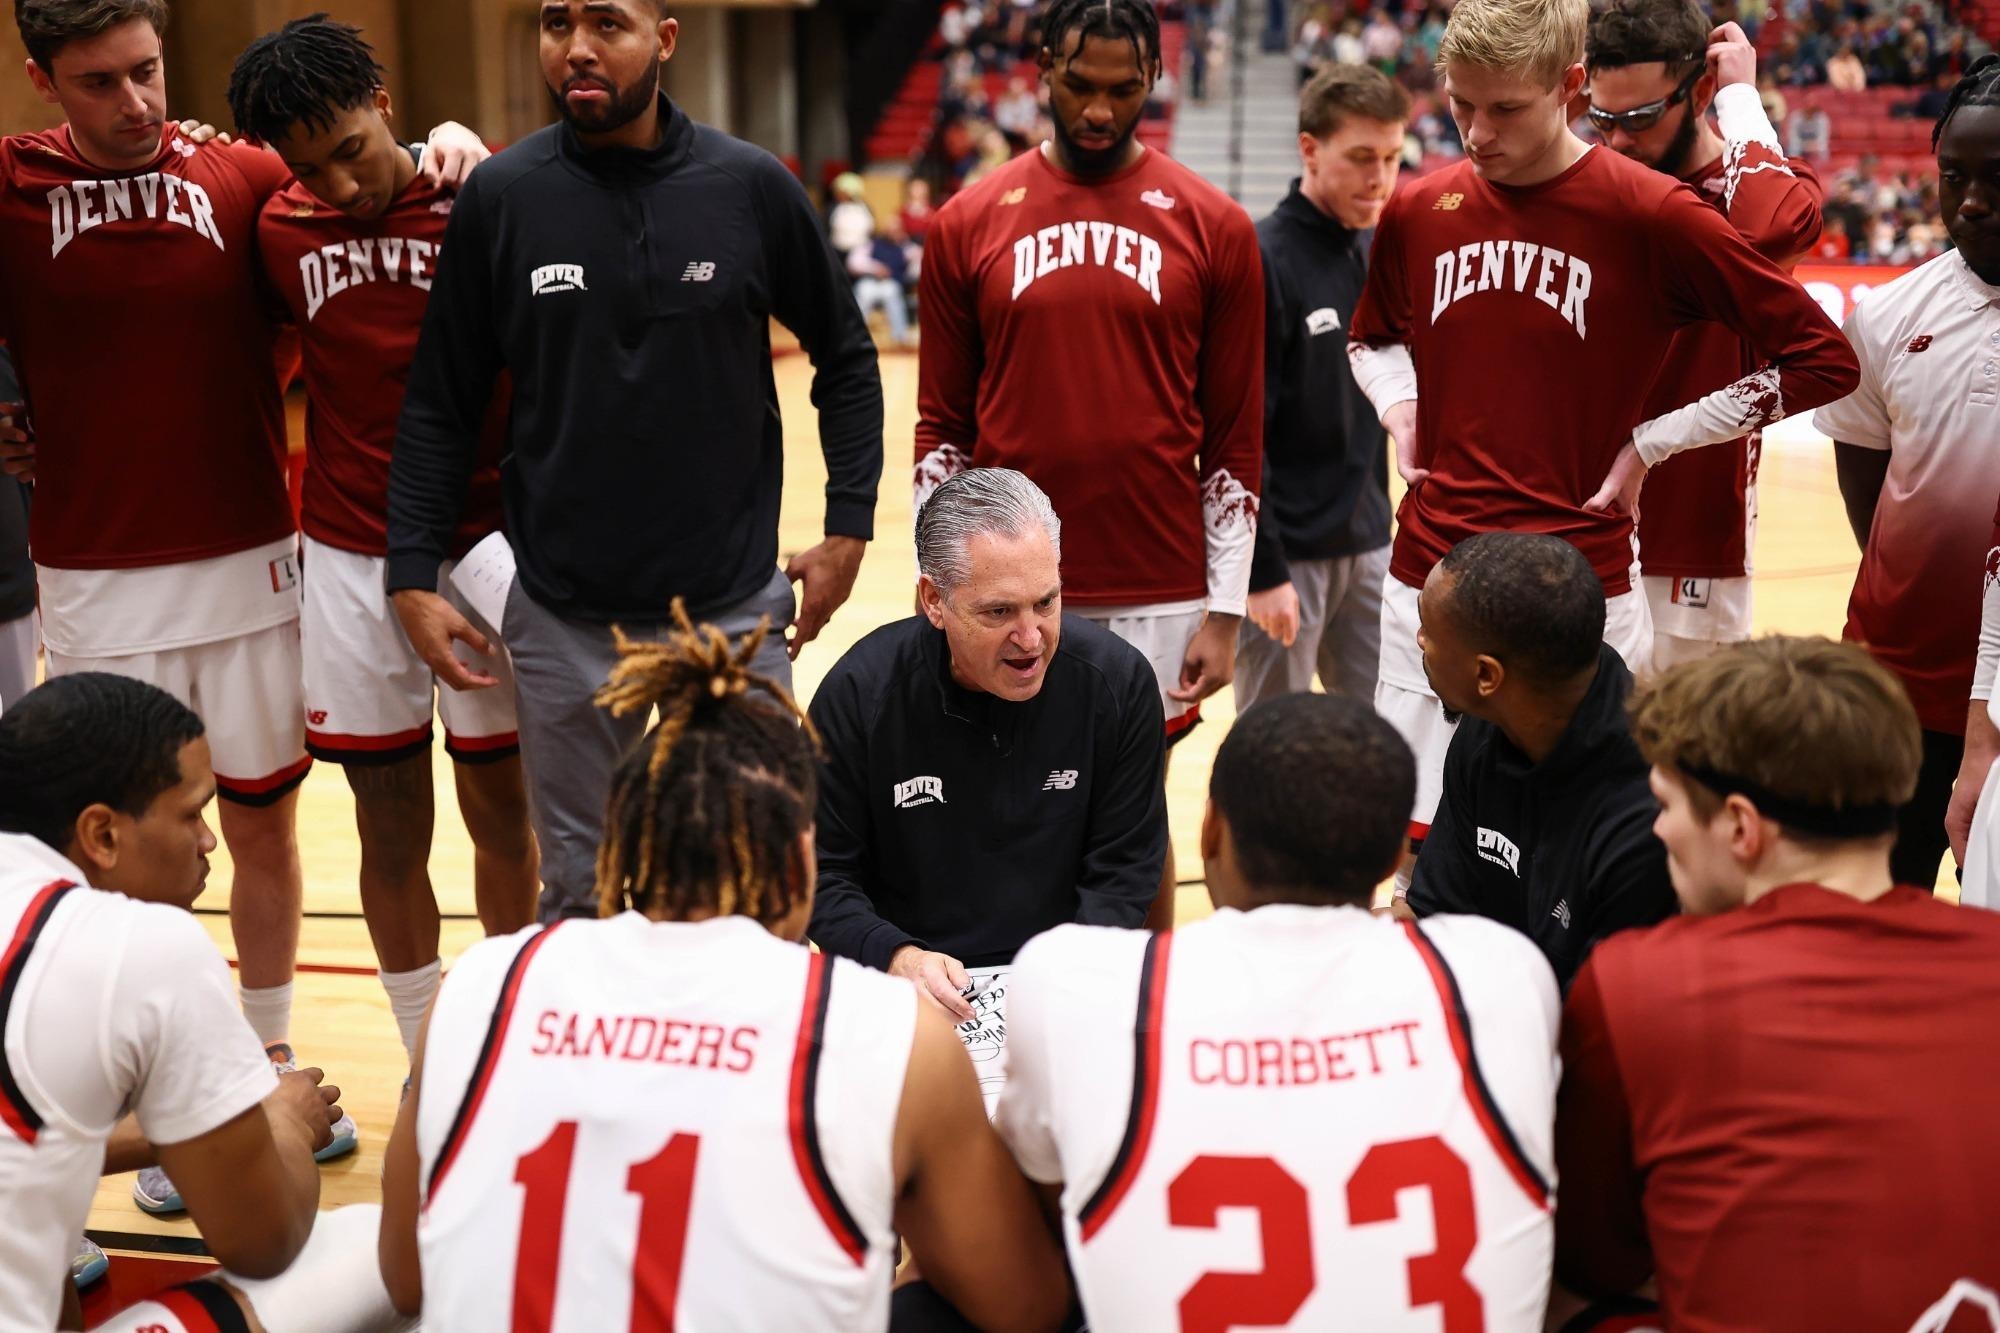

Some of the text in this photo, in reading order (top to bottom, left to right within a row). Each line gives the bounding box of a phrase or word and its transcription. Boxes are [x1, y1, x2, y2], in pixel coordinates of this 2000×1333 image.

[46, 172, 225, 260] DENVER
[300, 237, 442, 322] DENVE
[531, 264, 585, 297] DENVER
[1012, 221, 1162, 305] DENVER
[1431, 240, 1592, 341] DENVER
[894, 776, 944, 808] DENVER
[1477, 826, 1520, 876] ENVER
[531, 1010, 759, 1073] SANDERS
[1189, 1021, 1420, 1087] CORBETT
[511, 1120, 703, 1333] 11
[1166, 1135, 1486, 1333] 23
